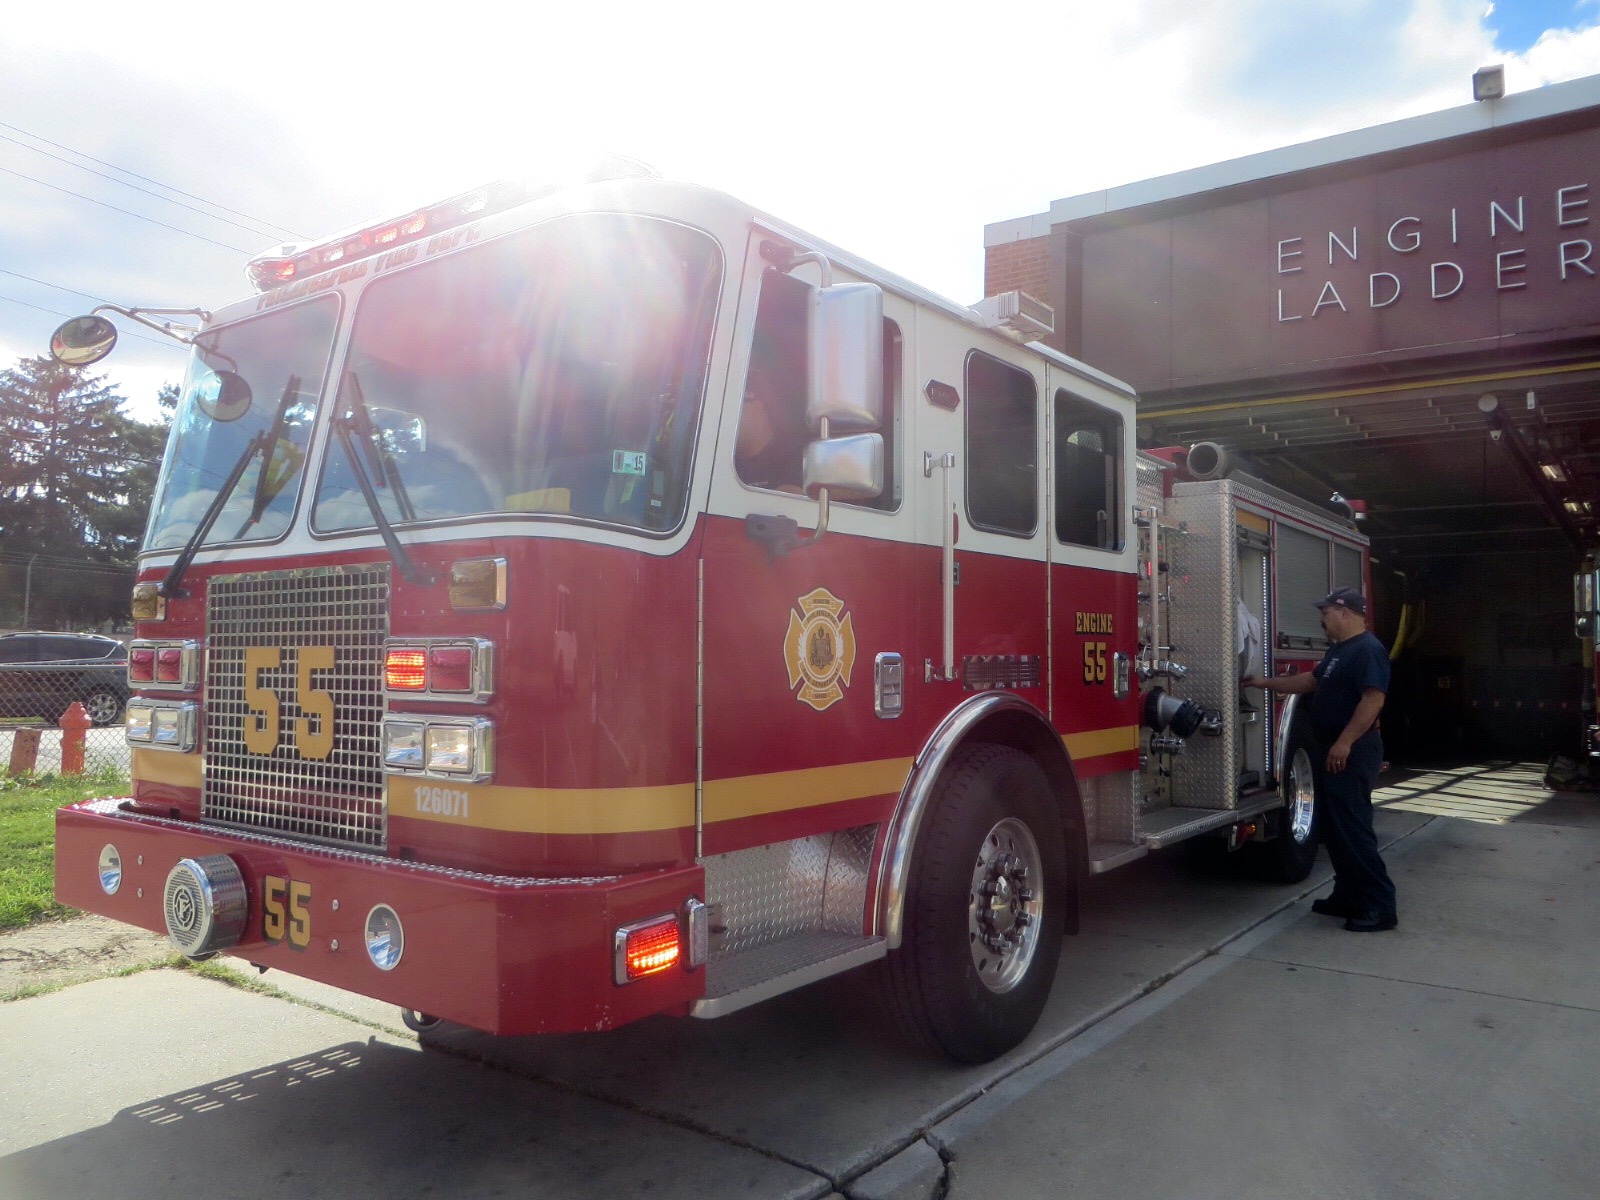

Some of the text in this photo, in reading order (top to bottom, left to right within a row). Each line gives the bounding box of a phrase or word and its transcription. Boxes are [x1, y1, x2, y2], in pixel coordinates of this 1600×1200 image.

[1278, 183, 1589, 274] ENGINE
[1277, 239, 1595, 322] LADDER
[634, 454, 643, 470] 15
[1075, 611, 1113, 634] ENGINE
[1083, 641, 1107, 683] 55
[243, 646, 335, 760] 55
[414, 785, 469, 818] 126071
[264, 874, 312, 949] 55
